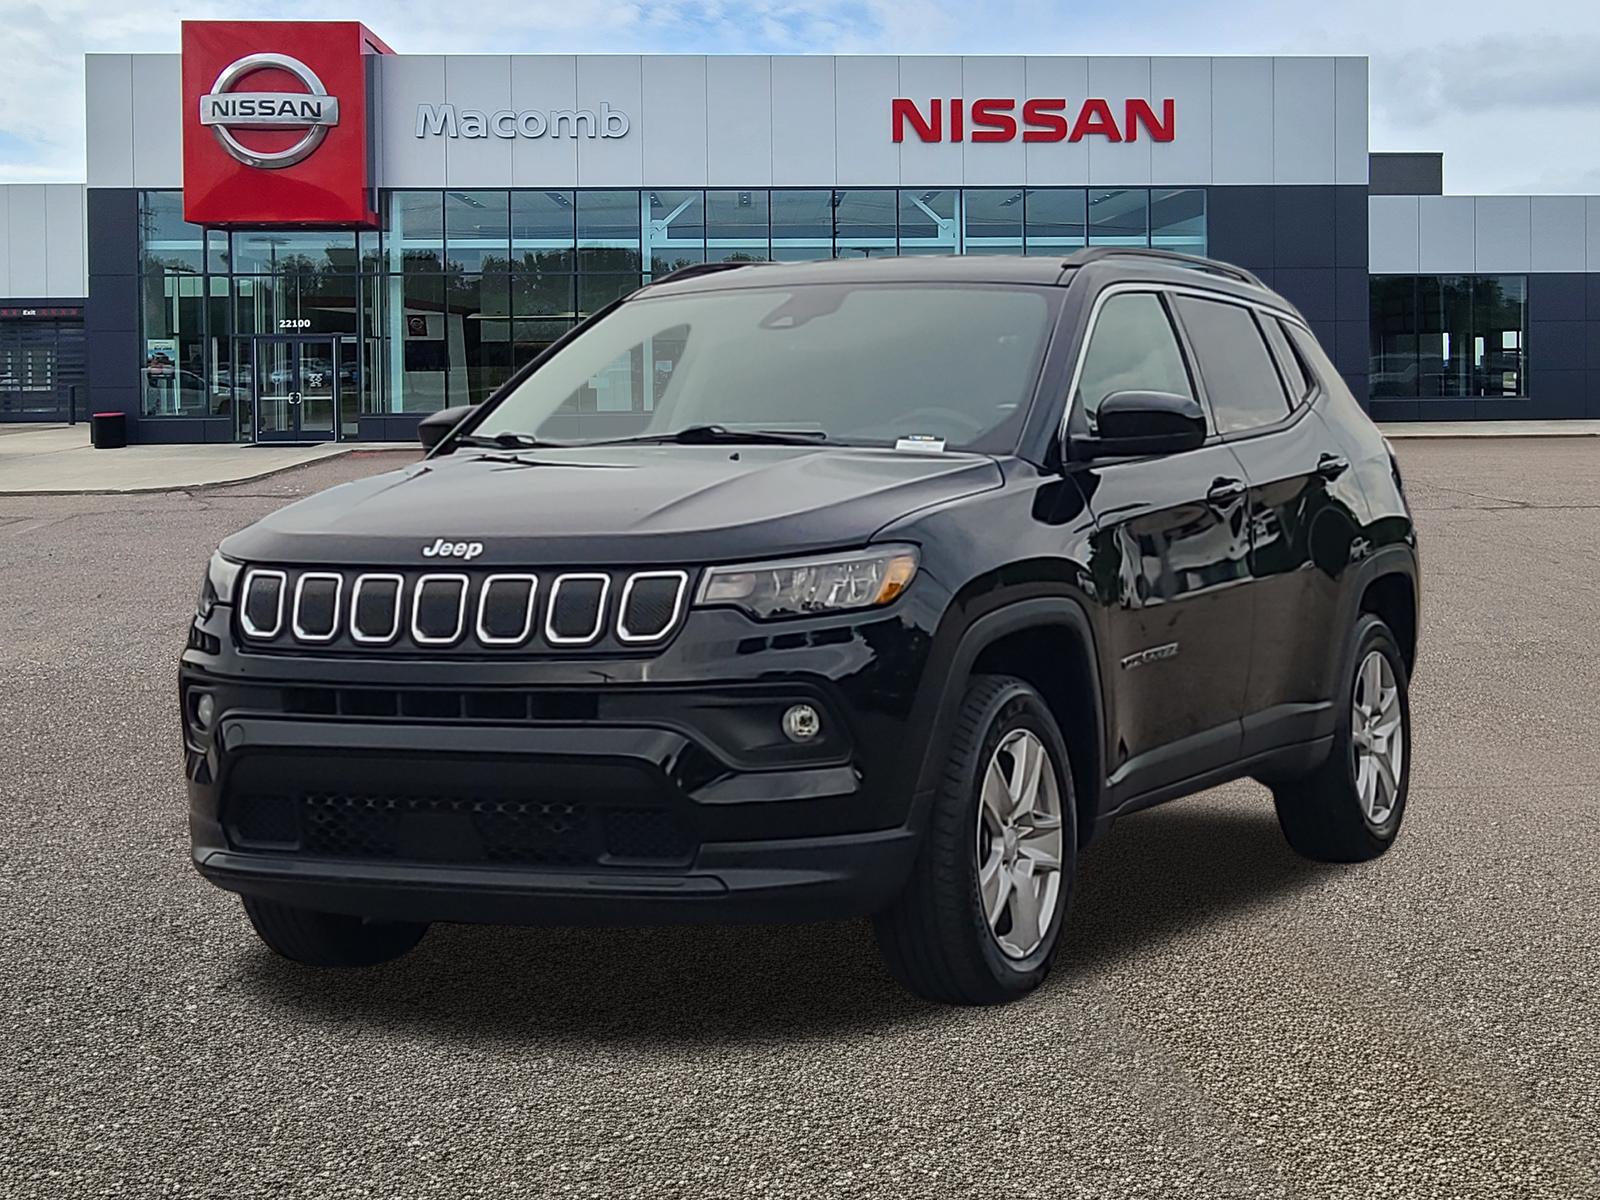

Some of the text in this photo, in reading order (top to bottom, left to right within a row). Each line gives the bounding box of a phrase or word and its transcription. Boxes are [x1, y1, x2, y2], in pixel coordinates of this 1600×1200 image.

[211, 100, 322, 117] NISSAN
[415, 102, 630, 138] Macomb
[892, 98, 1175, 143] NISSAN
[279, 319, 311, 328] 22100
[423, 538, 483, 560] Jeep
